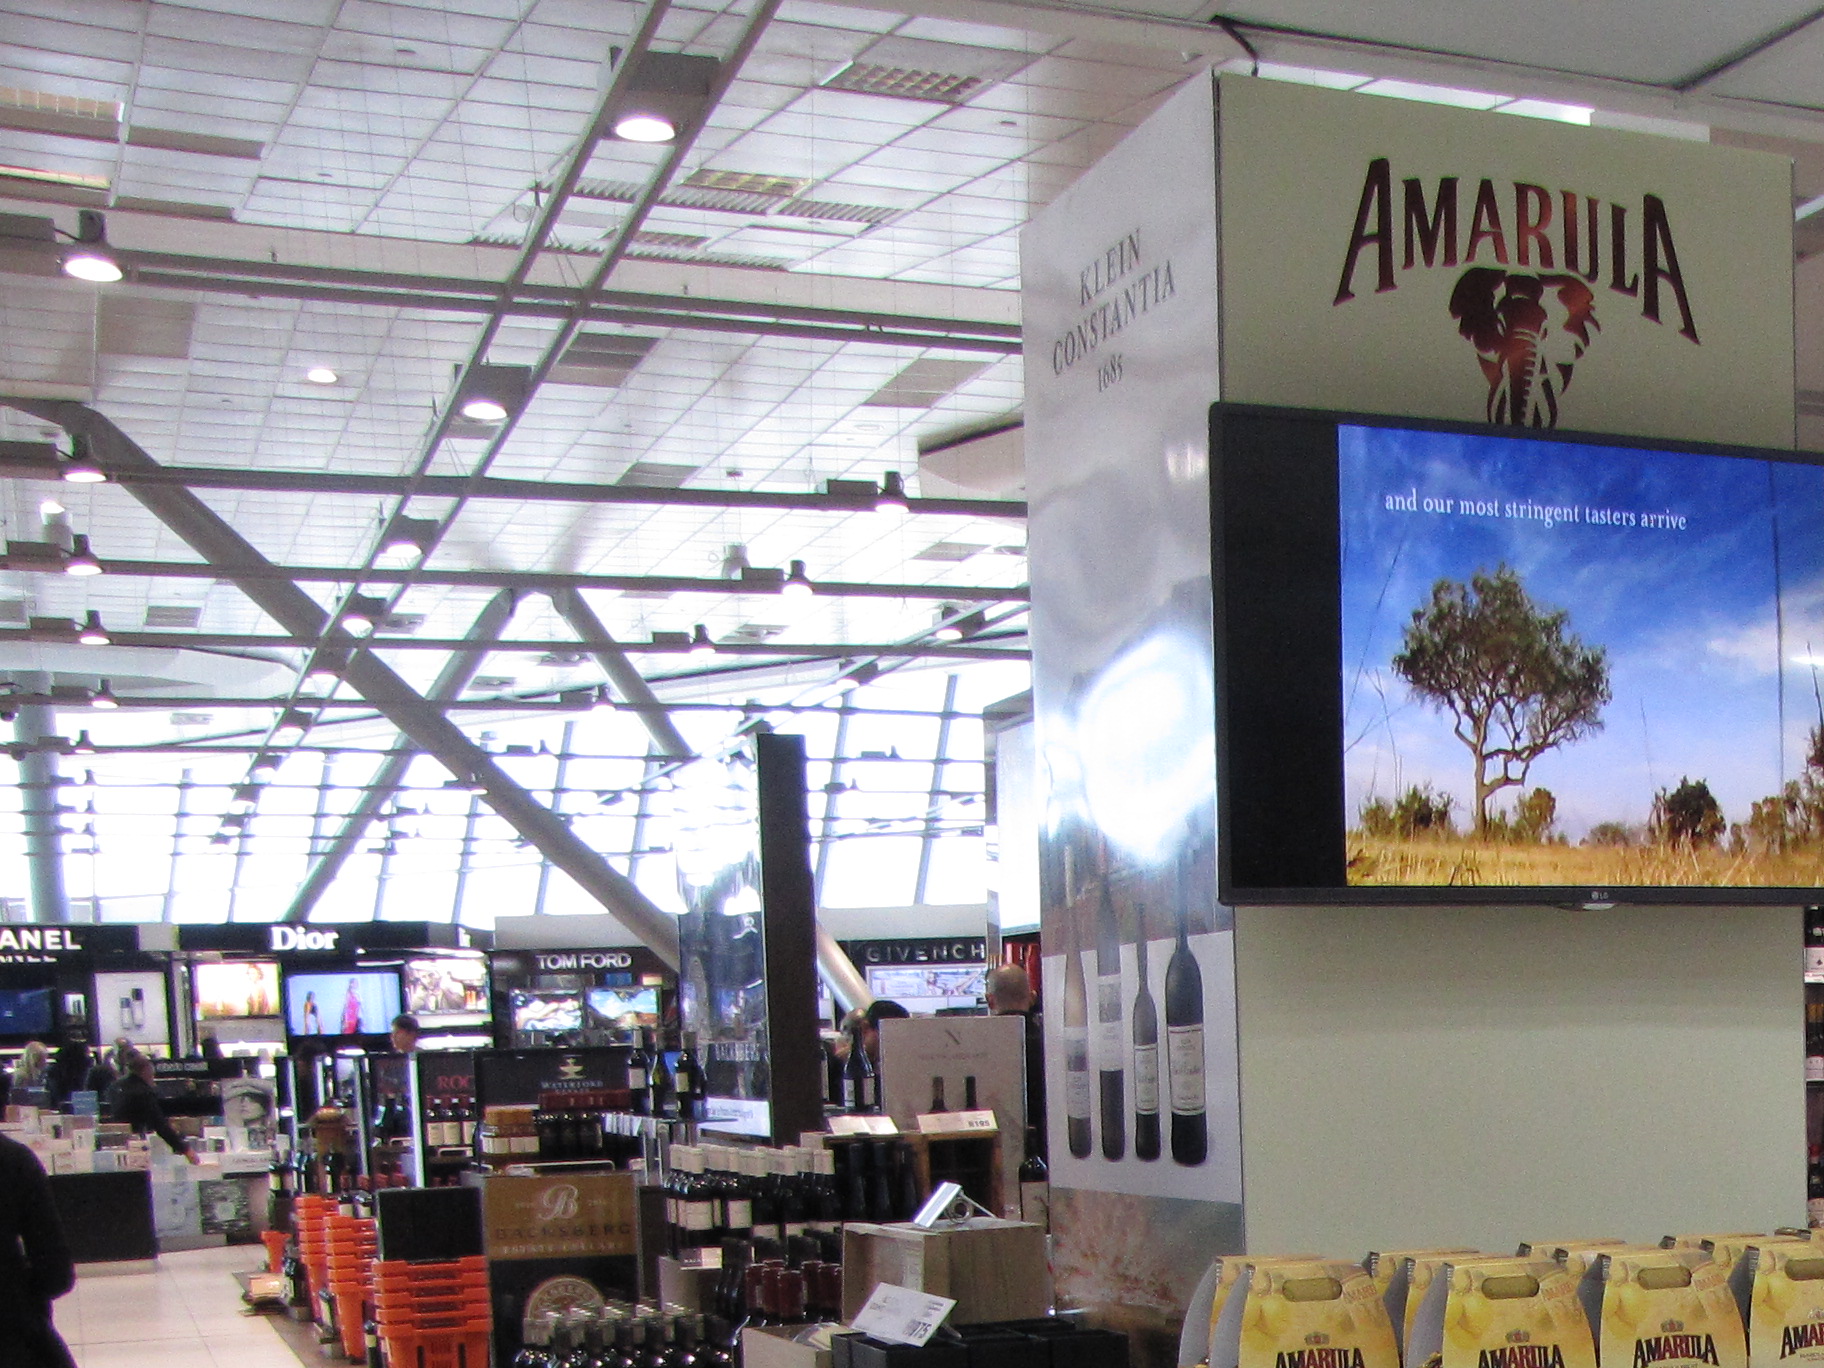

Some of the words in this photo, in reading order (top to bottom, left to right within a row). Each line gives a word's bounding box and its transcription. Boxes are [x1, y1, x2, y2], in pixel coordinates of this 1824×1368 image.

[1079, 228, 1140, 306] KLEIN
[1333, 157, 1701, 345] AMARULA
[1053, 260, 1175, 375] CONSTANTIA
[1098, 353, 1123, 392] 1685
[1385, 488, 1417, 512] and
[1423, 498, 1453, 514] our
[1460, 500, 1499, 517] most
[1504, 499, 1580, 528] stringent
[1585, 507, 1635, 527] tasters
[1640, 509, 1687, 531] arrive
[0, 928, 82, 950] ANEL
[269, 926, 340, 950] Dior
[865, 943, 986, 962] GIVENCH
[536, 954, 577, 970] TOM
[581, 953, 632, 969] FORD
